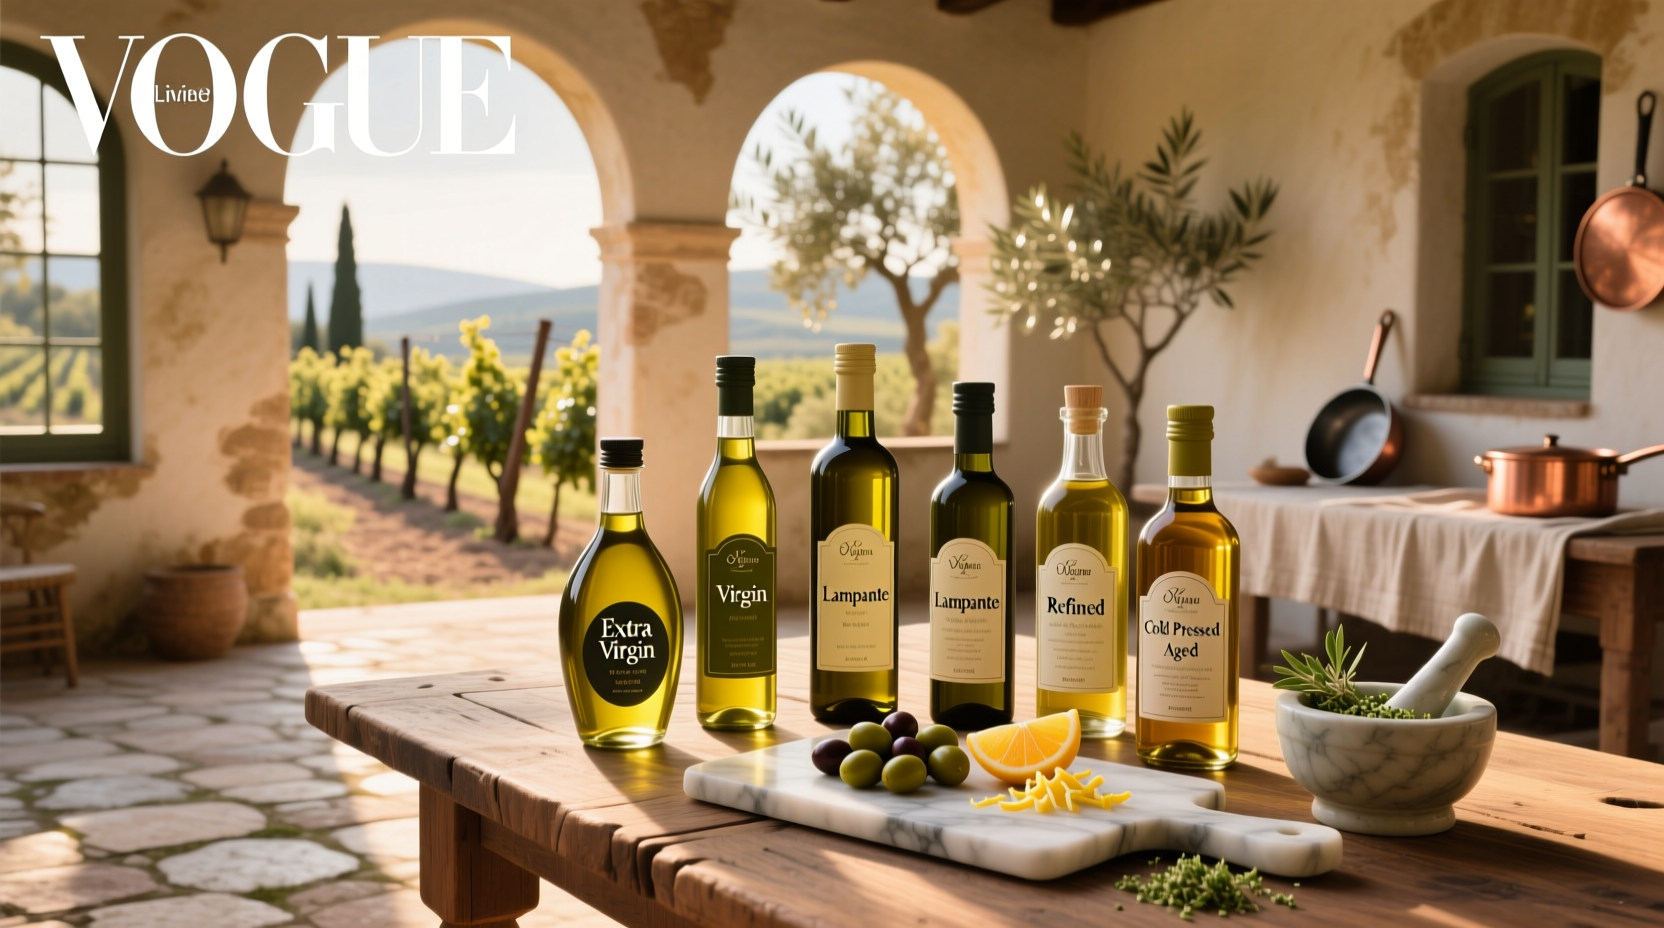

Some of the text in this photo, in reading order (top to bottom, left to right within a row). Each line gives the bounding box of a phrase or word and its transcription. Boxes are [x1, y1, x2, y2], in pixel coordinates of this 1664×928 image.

[716, 584, 768, 608] Virgin
[823, 585, 889, 607] Lampante
[935, 591, 1000, 613] Lampante
[1047, 596, 1105, 615] Refined
[601, 618, 653, 638] Extra
[1144, 620, 1220, 637] Cold Pressed
[598, 640, 656, 665] Virgin
[1164, 642, 1199, 662] Aged
